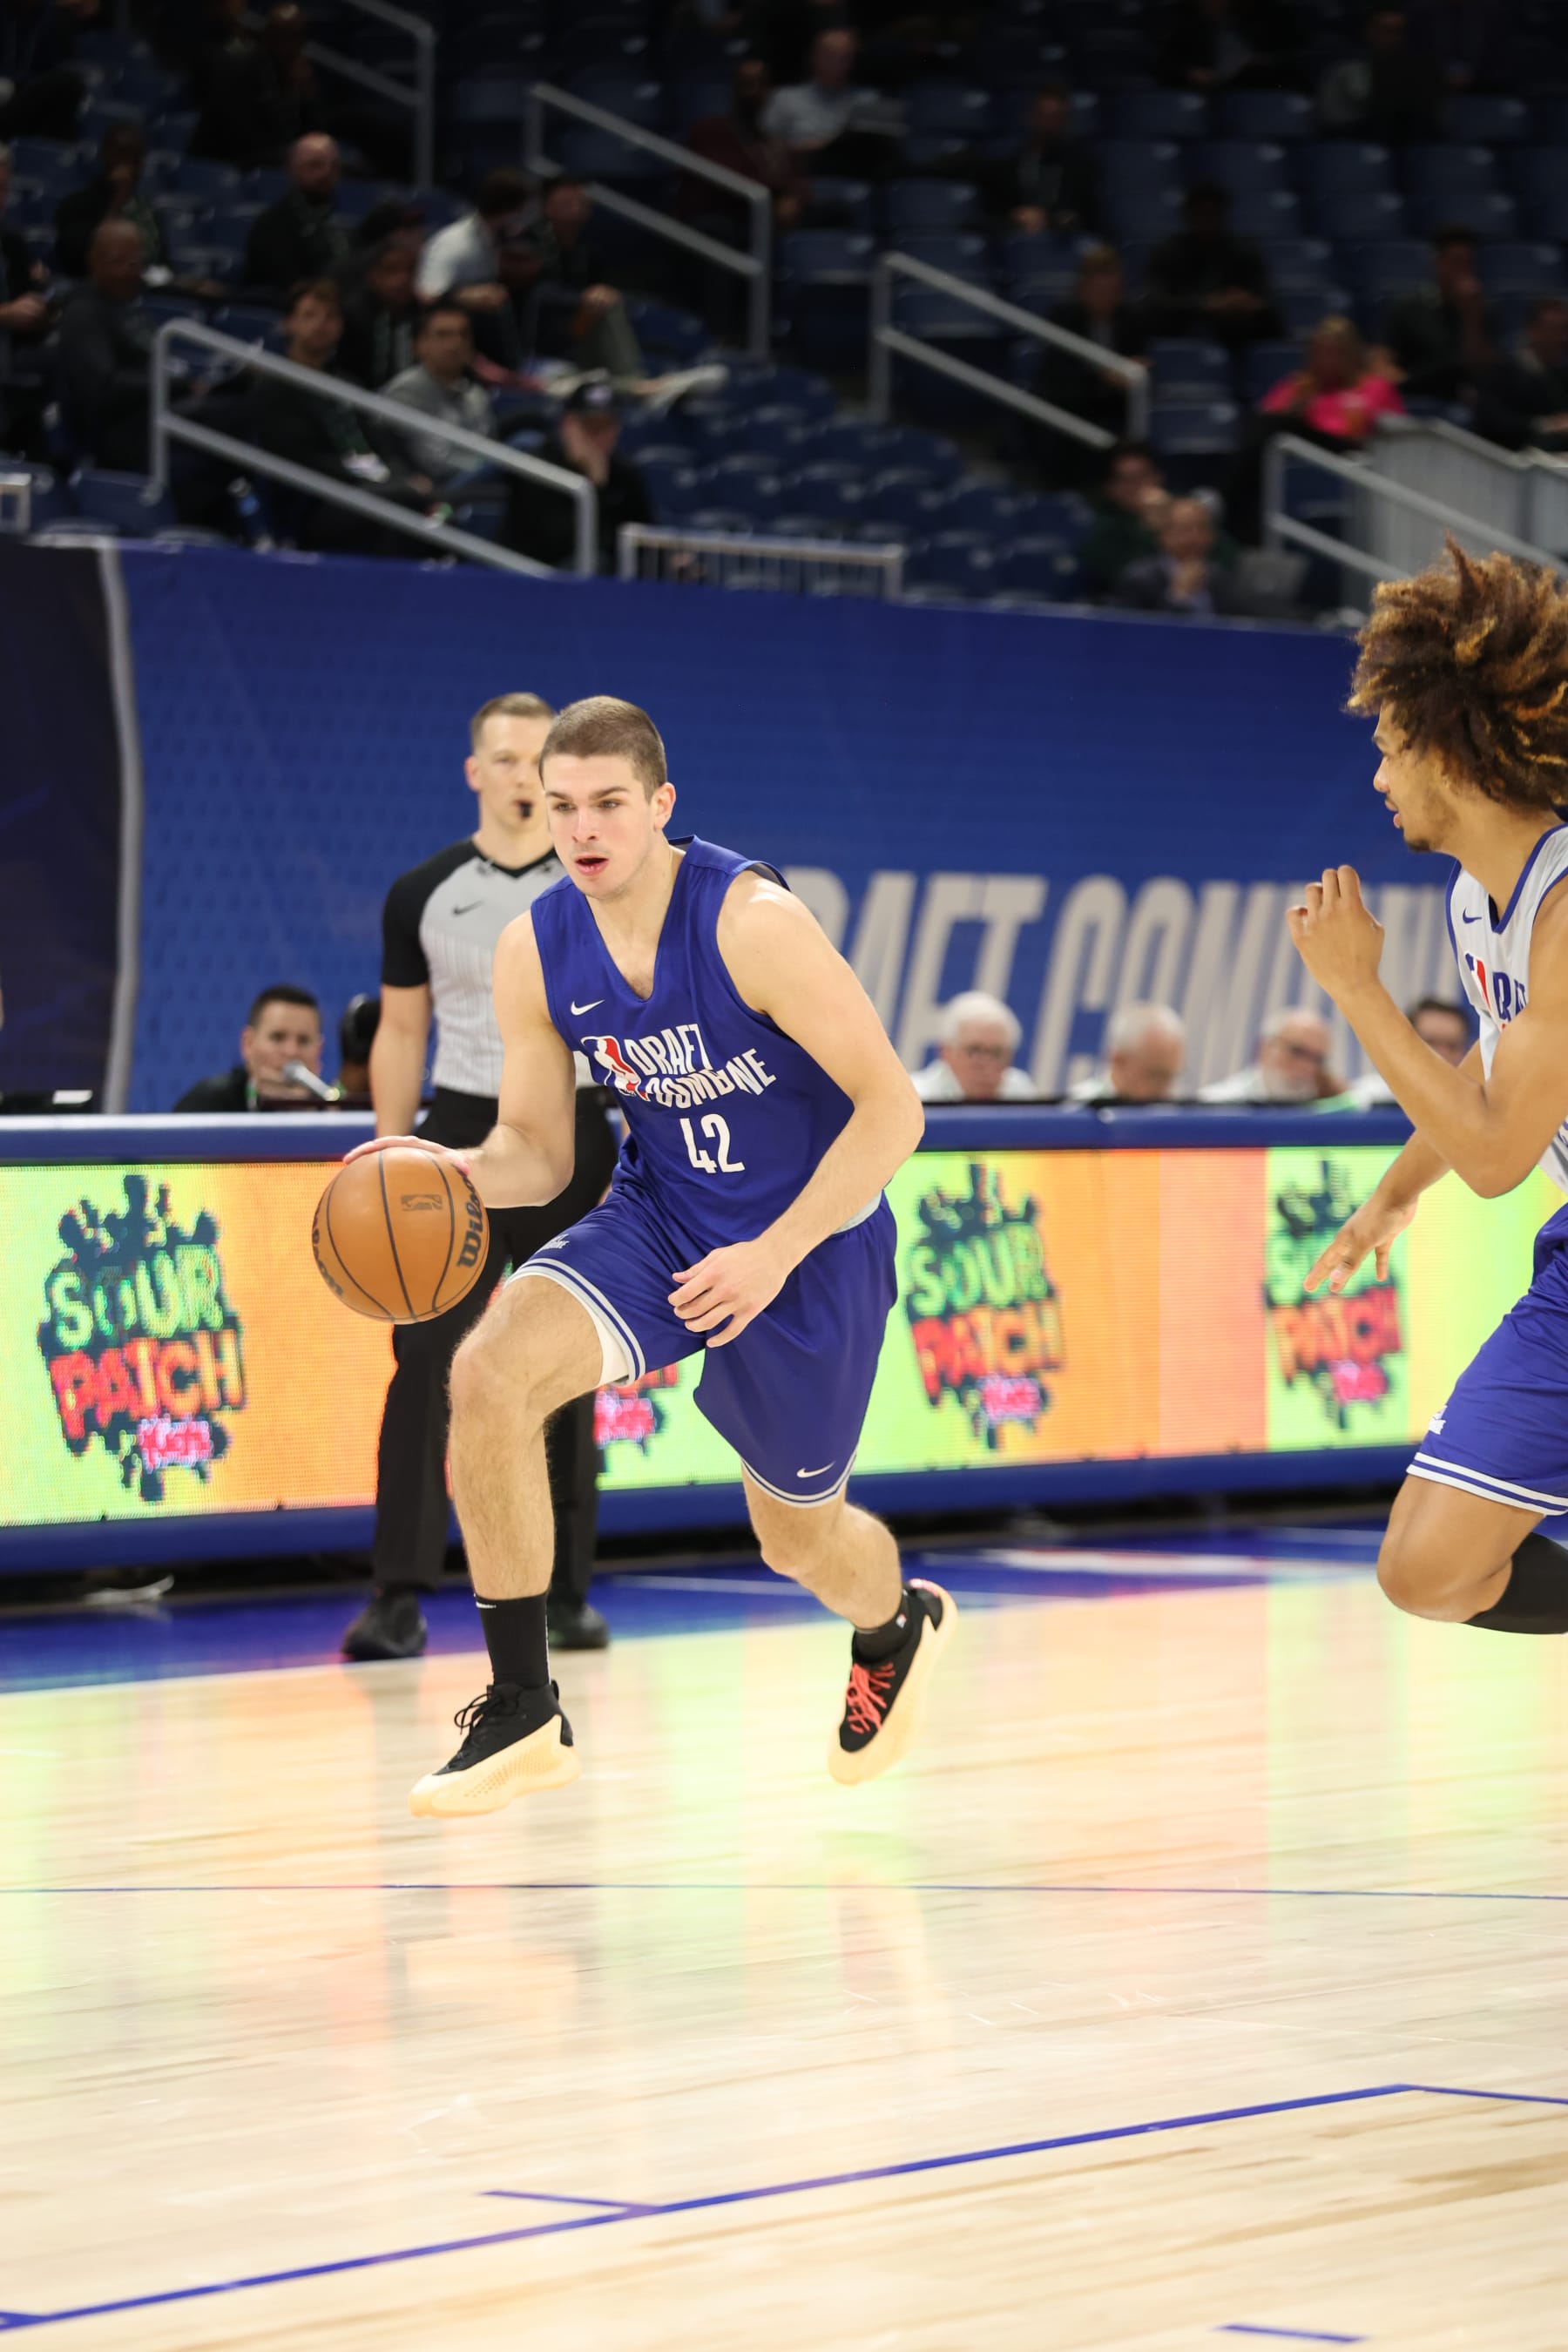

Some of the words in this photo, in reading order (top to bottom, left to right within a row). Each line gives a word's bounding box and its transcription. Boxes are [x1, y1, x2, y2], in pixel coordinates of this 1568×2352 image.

[624, 1024, 713, 1076] DRAFT
[645, 1048, 776, 1109] COMBNE
[679, 1113, 746, 1174] 42
[51, 1244, 225, 1350] SOUR
[49, 1328, 245, 1438] PATCH
[911, 1301, 1063, 1401] PATCH
